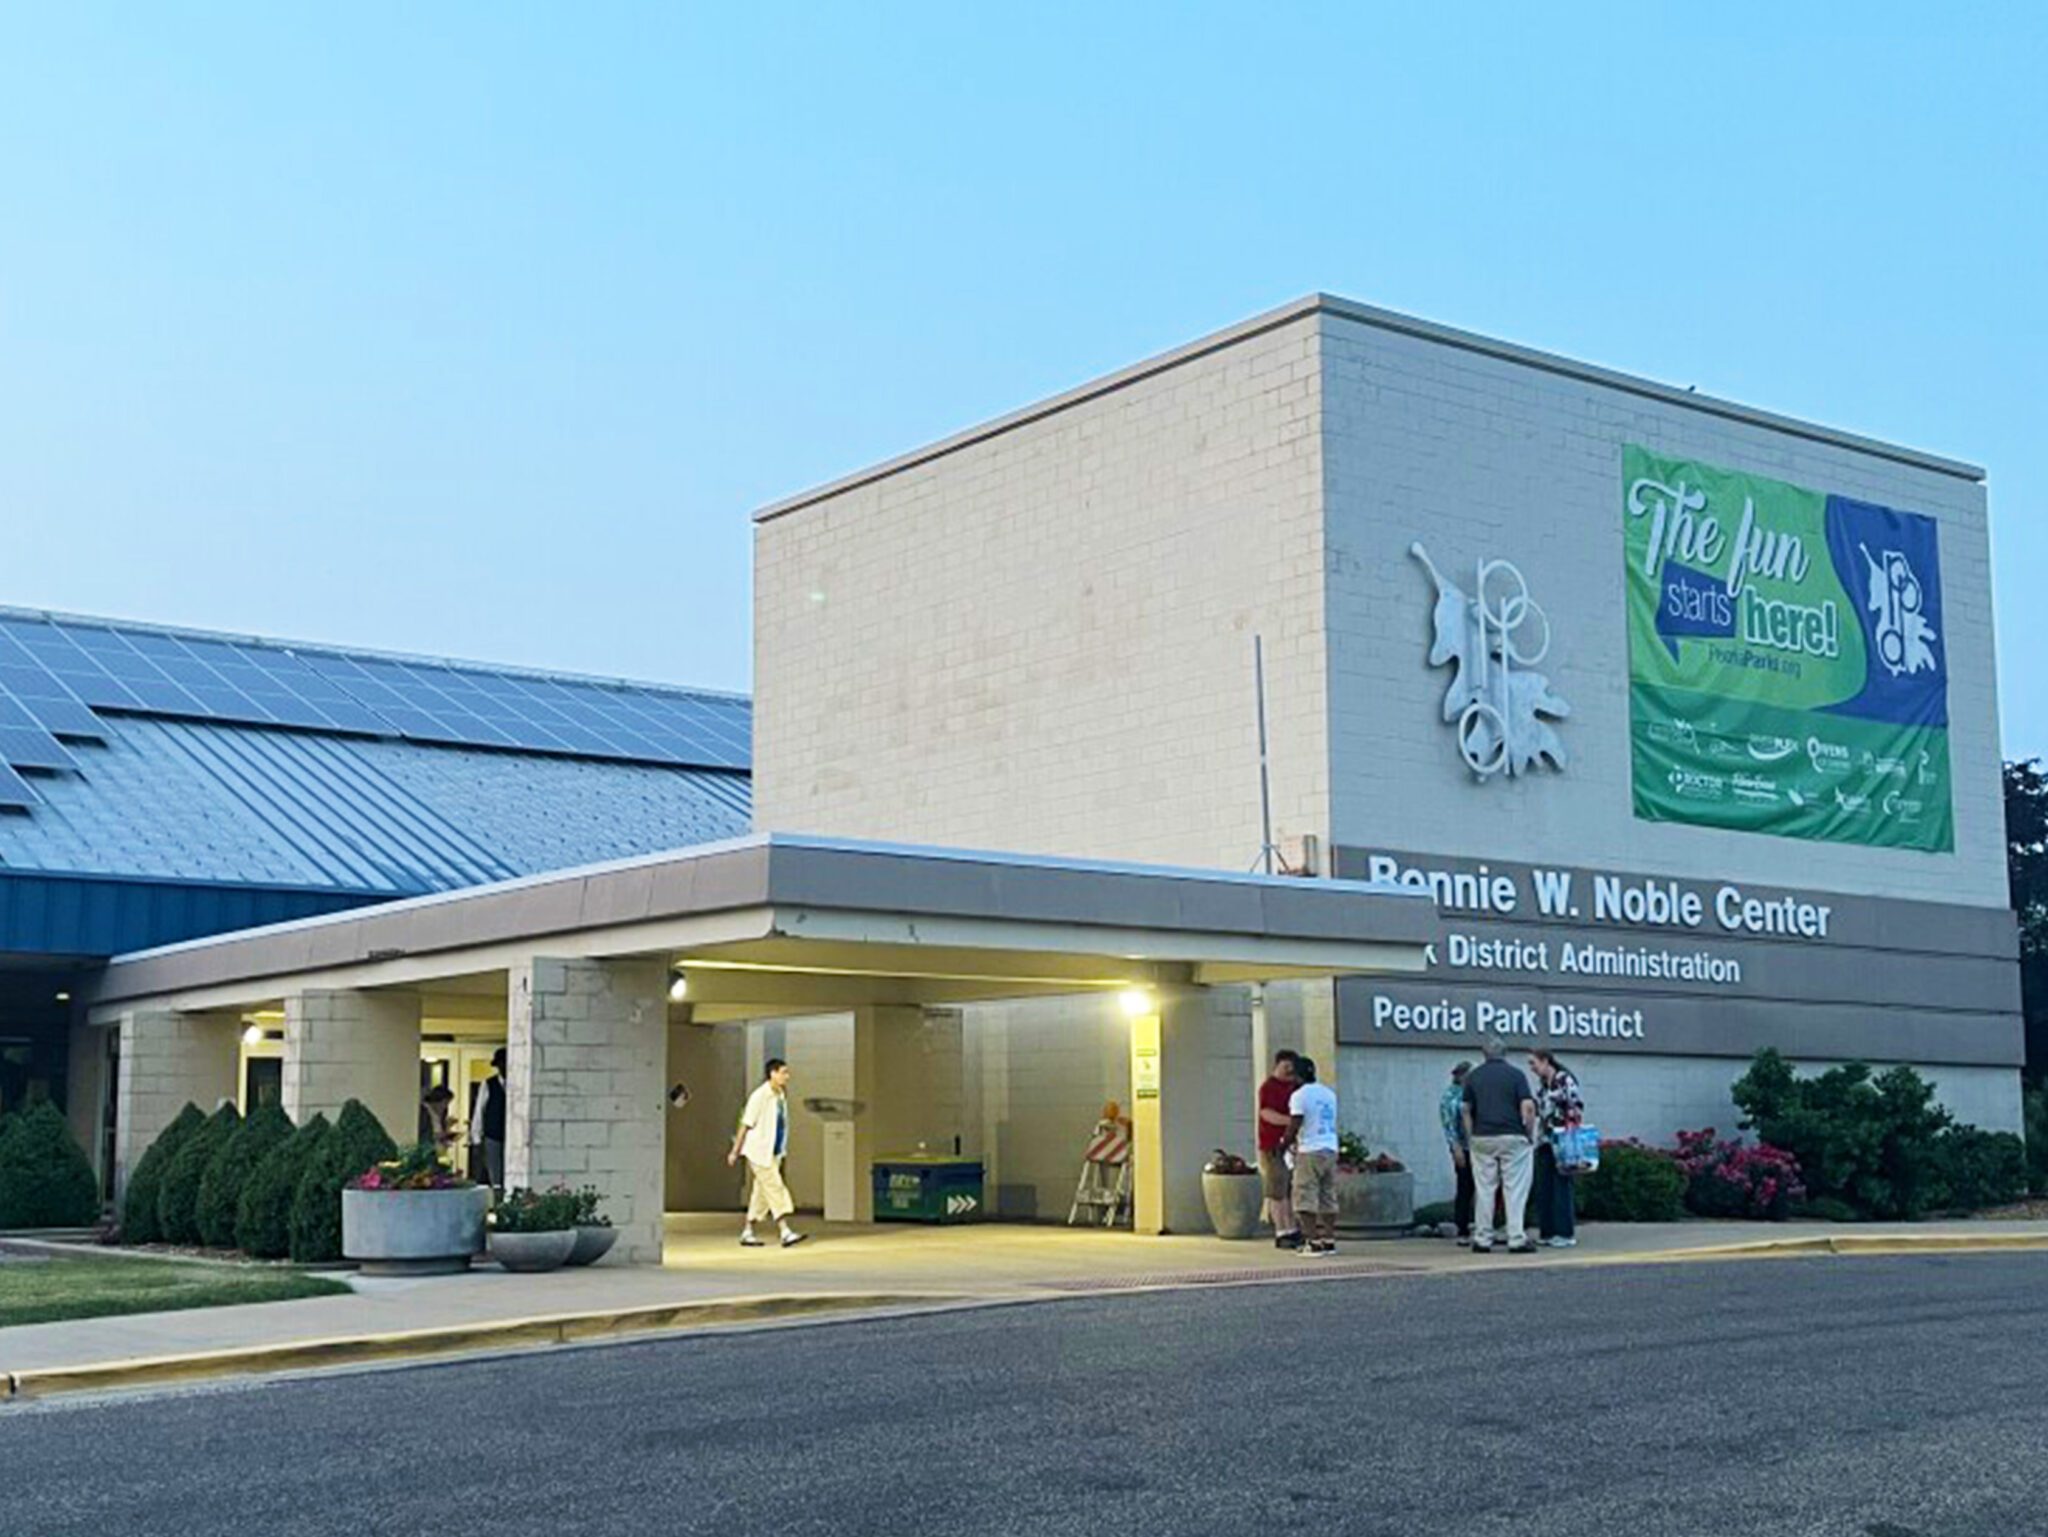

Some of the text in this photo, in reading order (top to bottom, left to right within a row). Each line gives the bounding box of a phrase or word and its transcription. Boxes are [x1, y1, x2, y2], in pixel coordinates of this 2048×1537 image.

[1627, 478, 1811, 598] The fun
[1668, 578, 1839, 658] starts here!
[1533, 869, 1579, 917] W.
[1594, 875, 1703, 926] Noble
[1716, 886, 1831, 937] Center
[1449, 935, 1549, 971] District
[1560, 941, 1741, 983] Administration
[1373, 996, 1645, 1039] Peoria Park District
